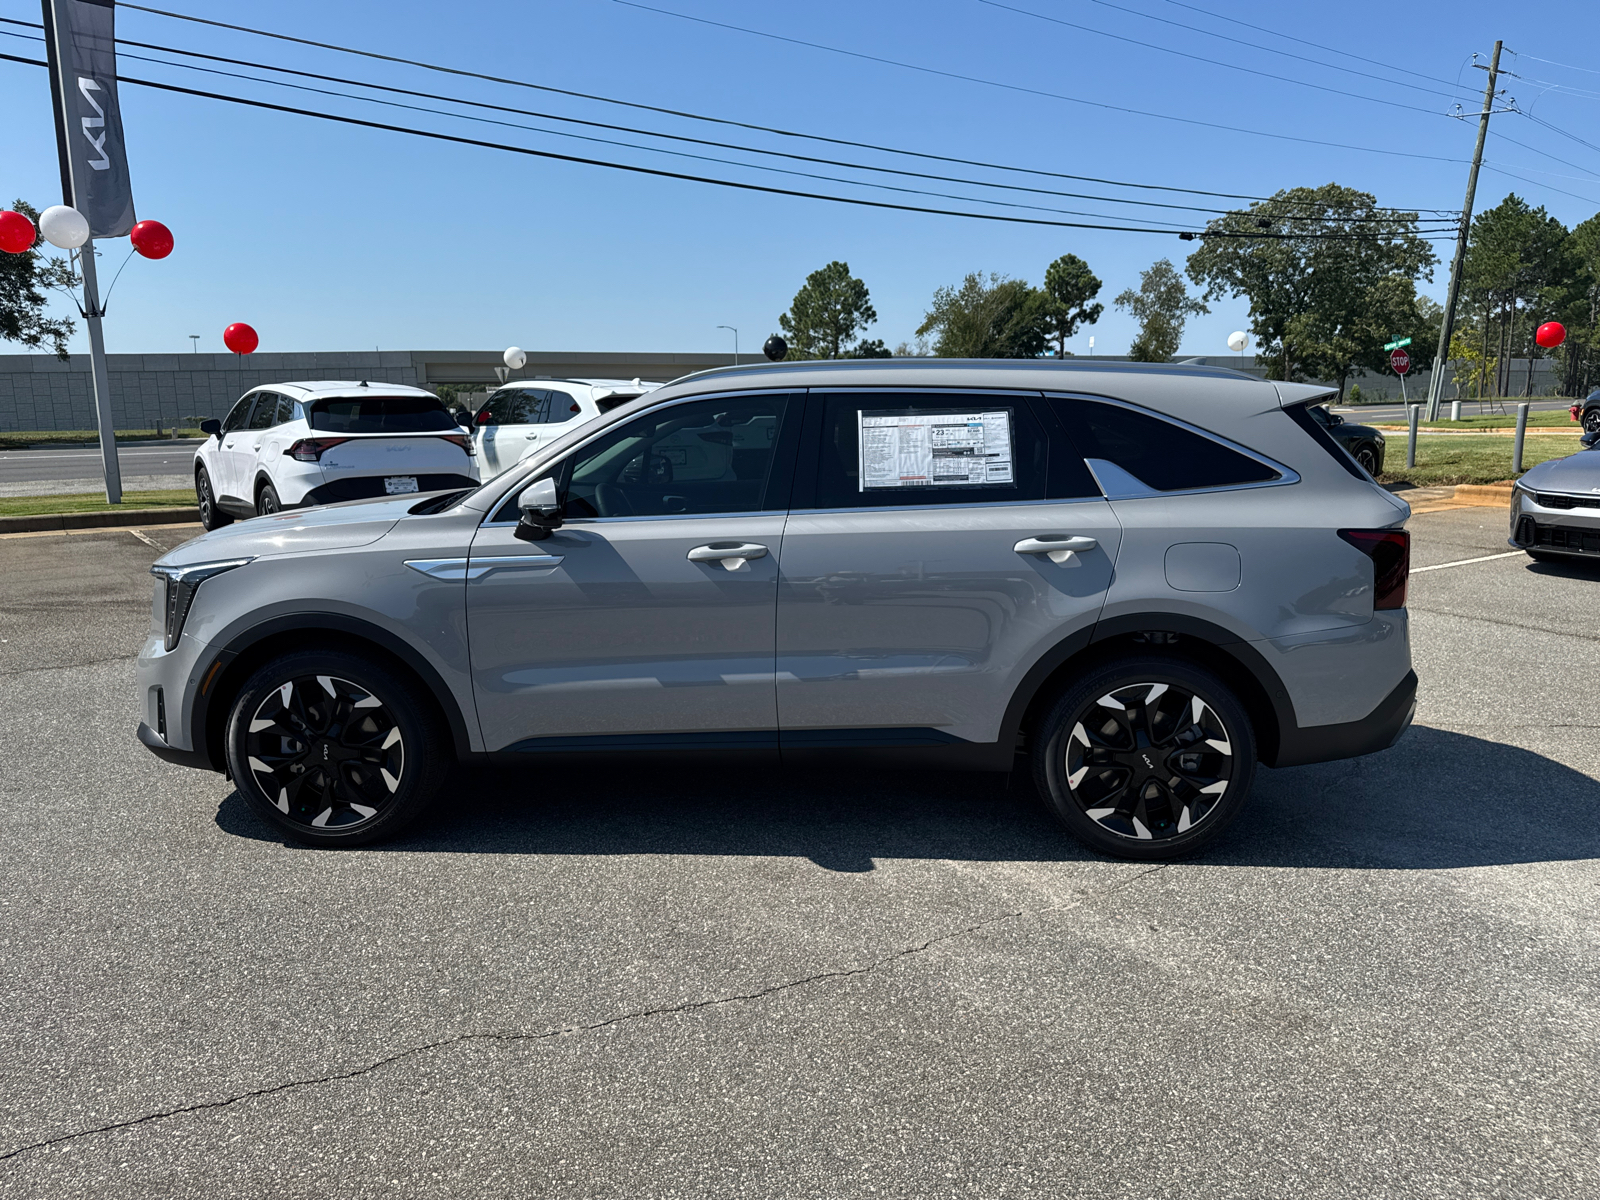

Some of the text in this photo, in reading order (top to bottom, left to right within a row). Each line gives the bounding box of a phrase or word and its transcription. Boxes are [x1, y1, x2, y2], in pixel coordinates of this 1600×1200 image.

[78, 76, 110, 171] KIA
[1392, 356, 1408, 367] STOP
[1141, 753, 1154, 769] KIA
